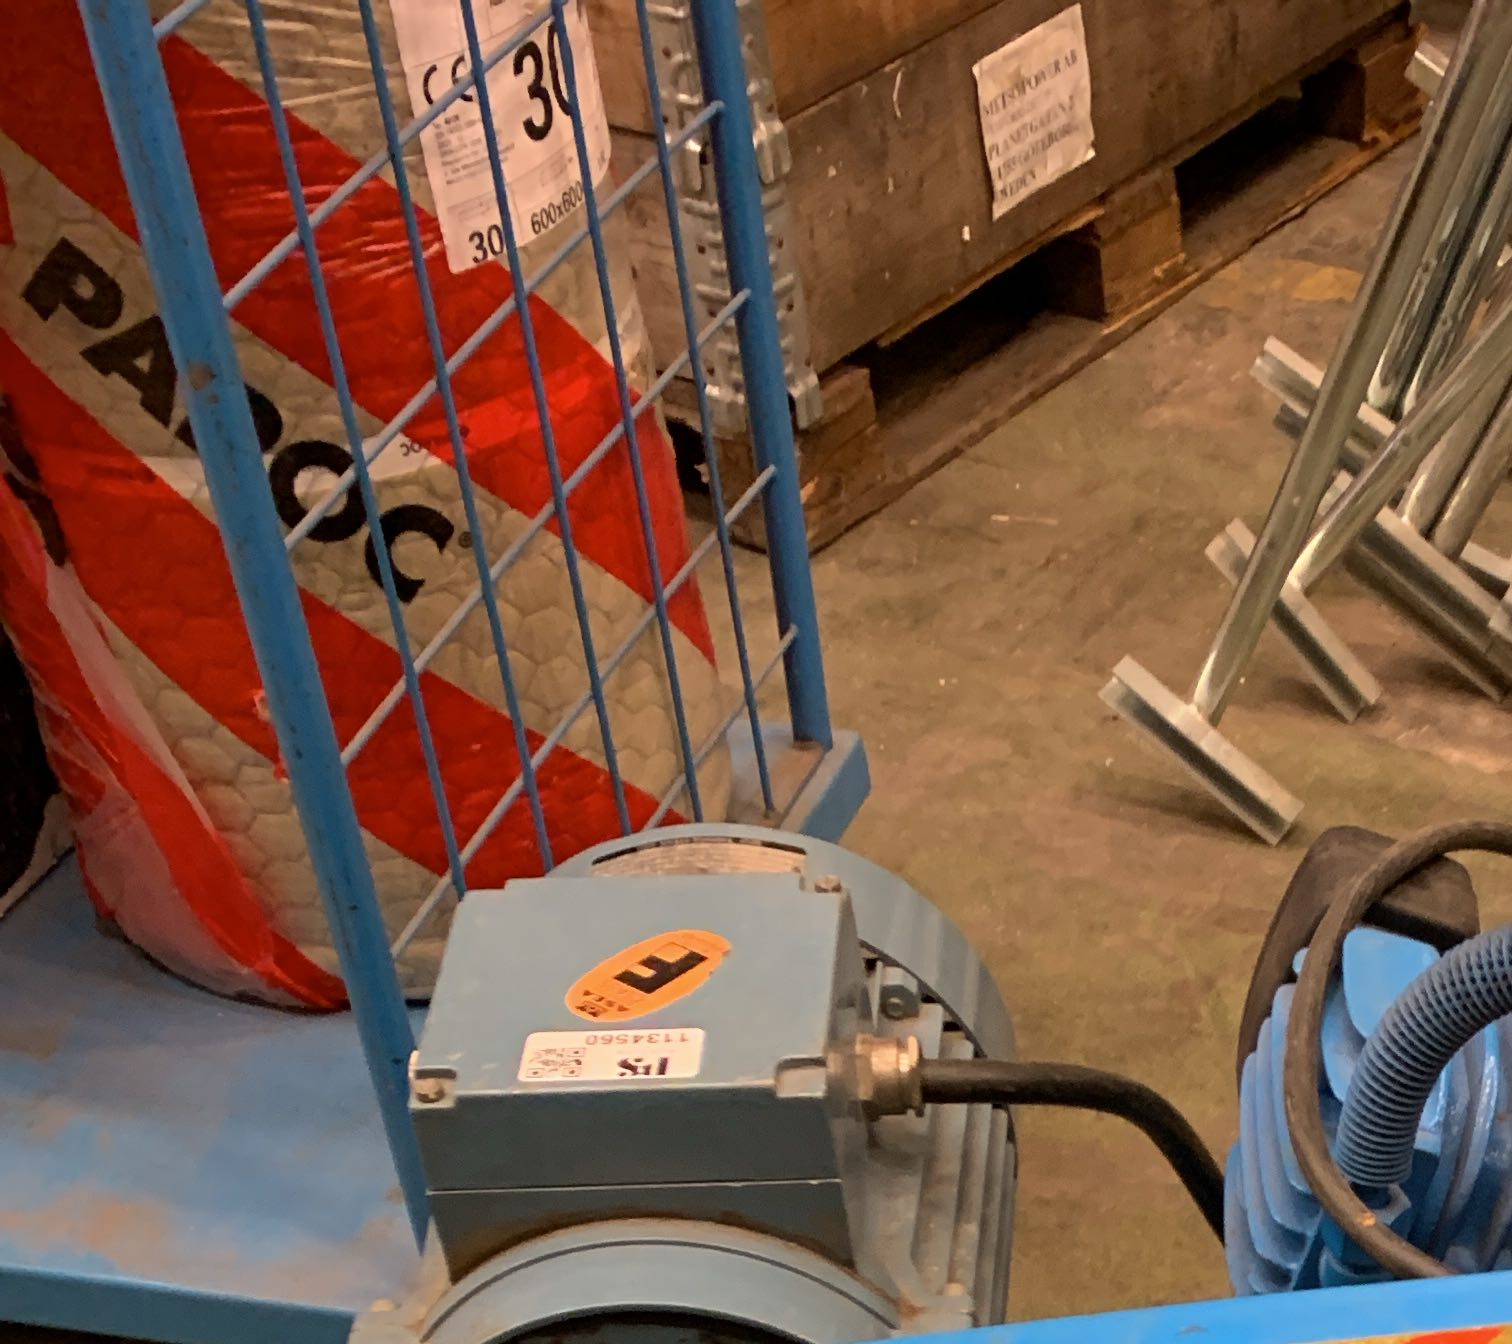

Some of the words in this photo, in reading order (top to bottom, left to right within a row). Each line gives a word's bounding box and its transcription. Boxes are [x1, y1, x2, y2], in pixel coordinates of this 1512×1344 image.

[530, 180, 586, 235] 600x600
[468, 224, 505, 264] 30
[585, 1032, 689, 1046] 1134560
